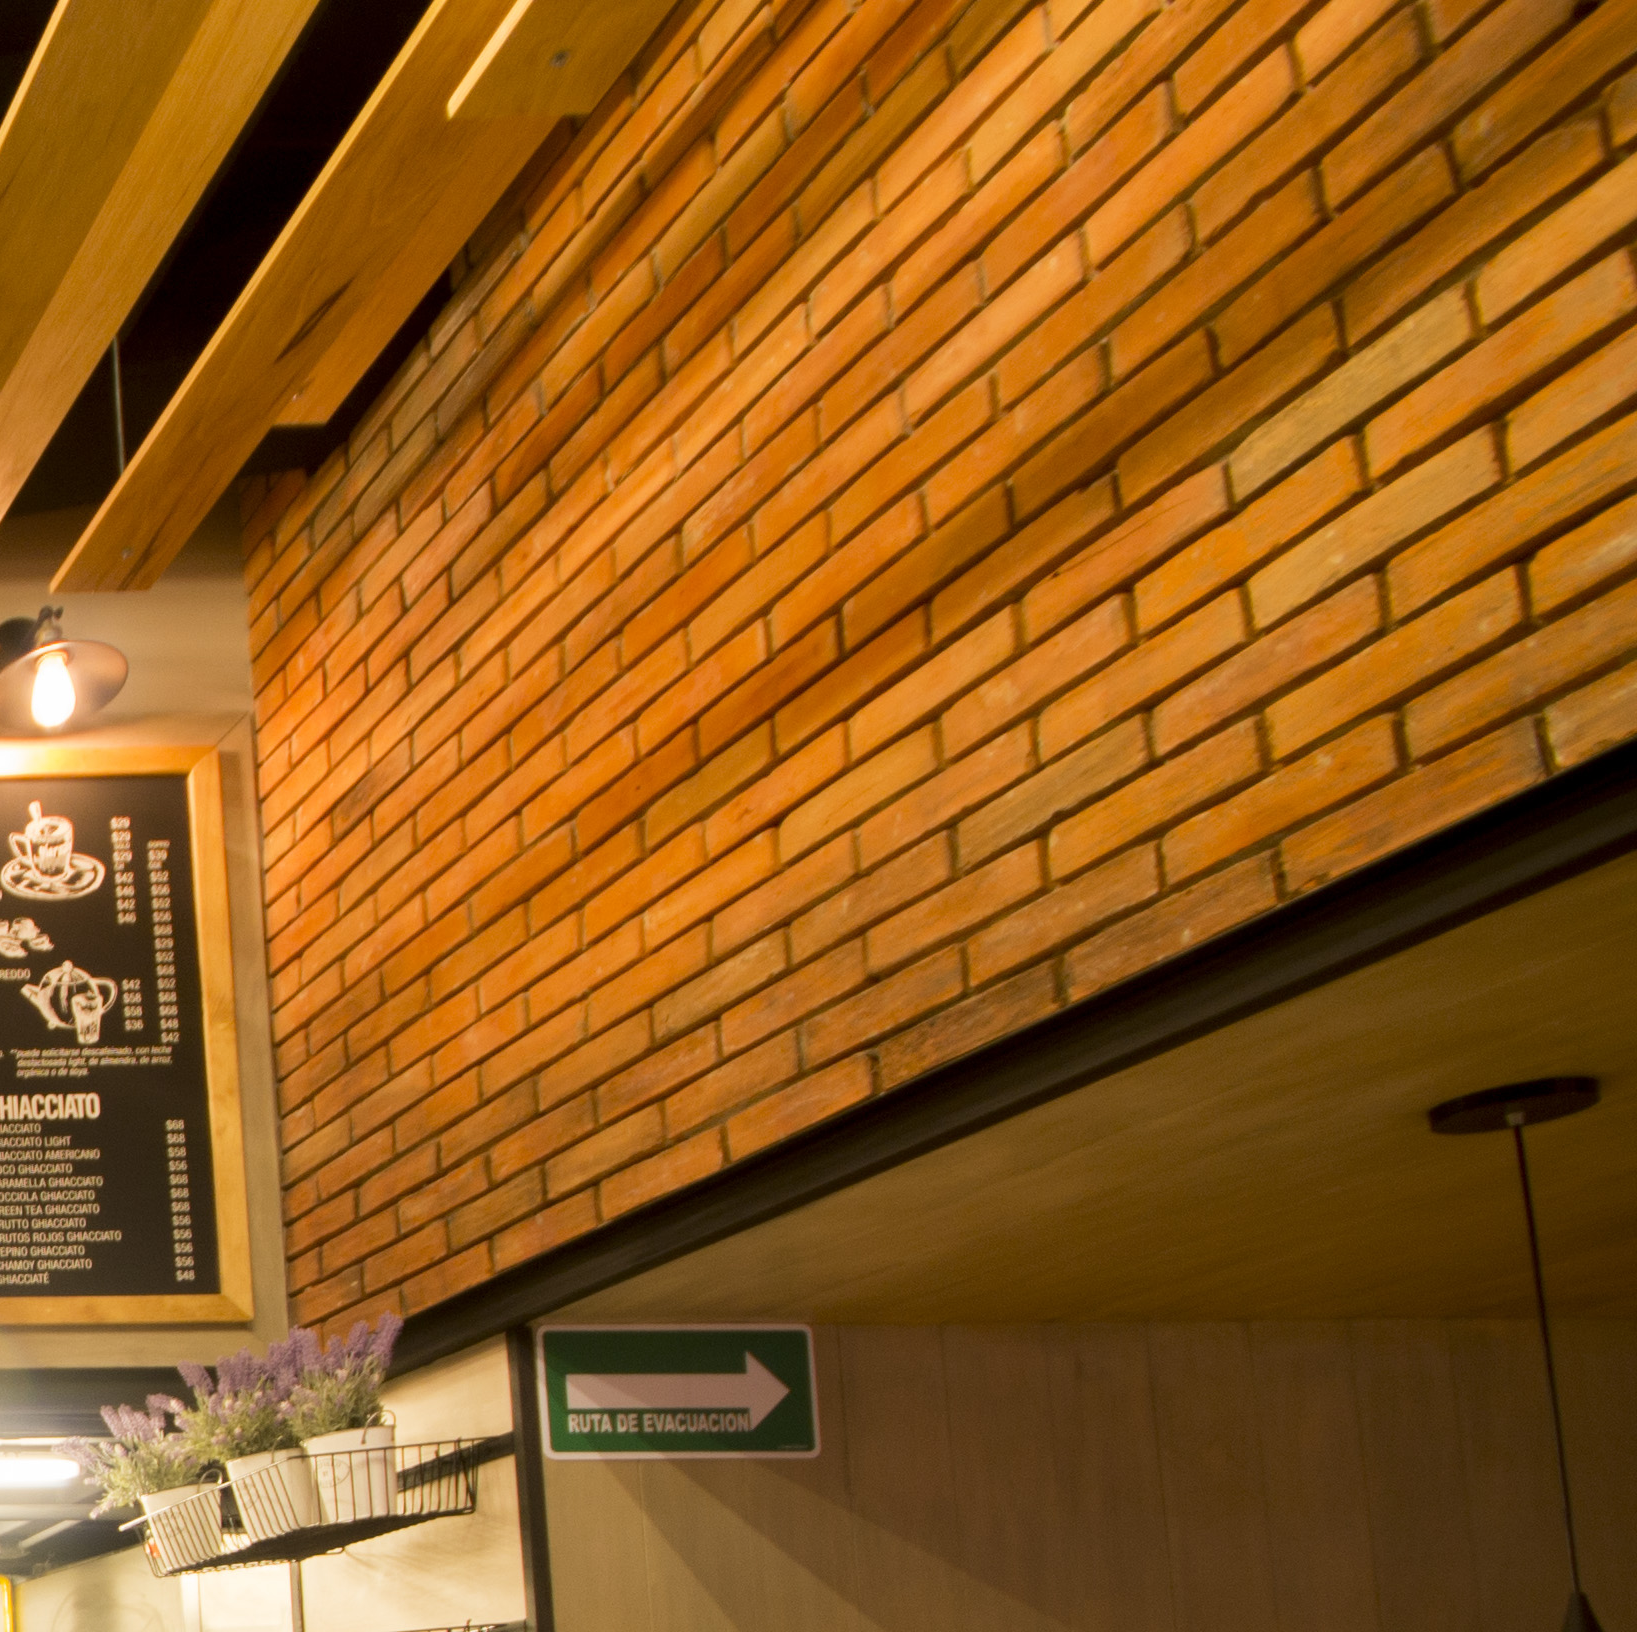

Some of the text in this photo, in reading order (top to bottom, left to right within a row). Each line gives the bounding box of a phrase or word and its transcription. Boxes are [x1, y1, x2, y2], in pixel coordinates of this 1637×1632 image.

[44, 1135, 71, 1147] LIGHT
[568, 1413, 751, 1432] RUTA DE EVACUACION
